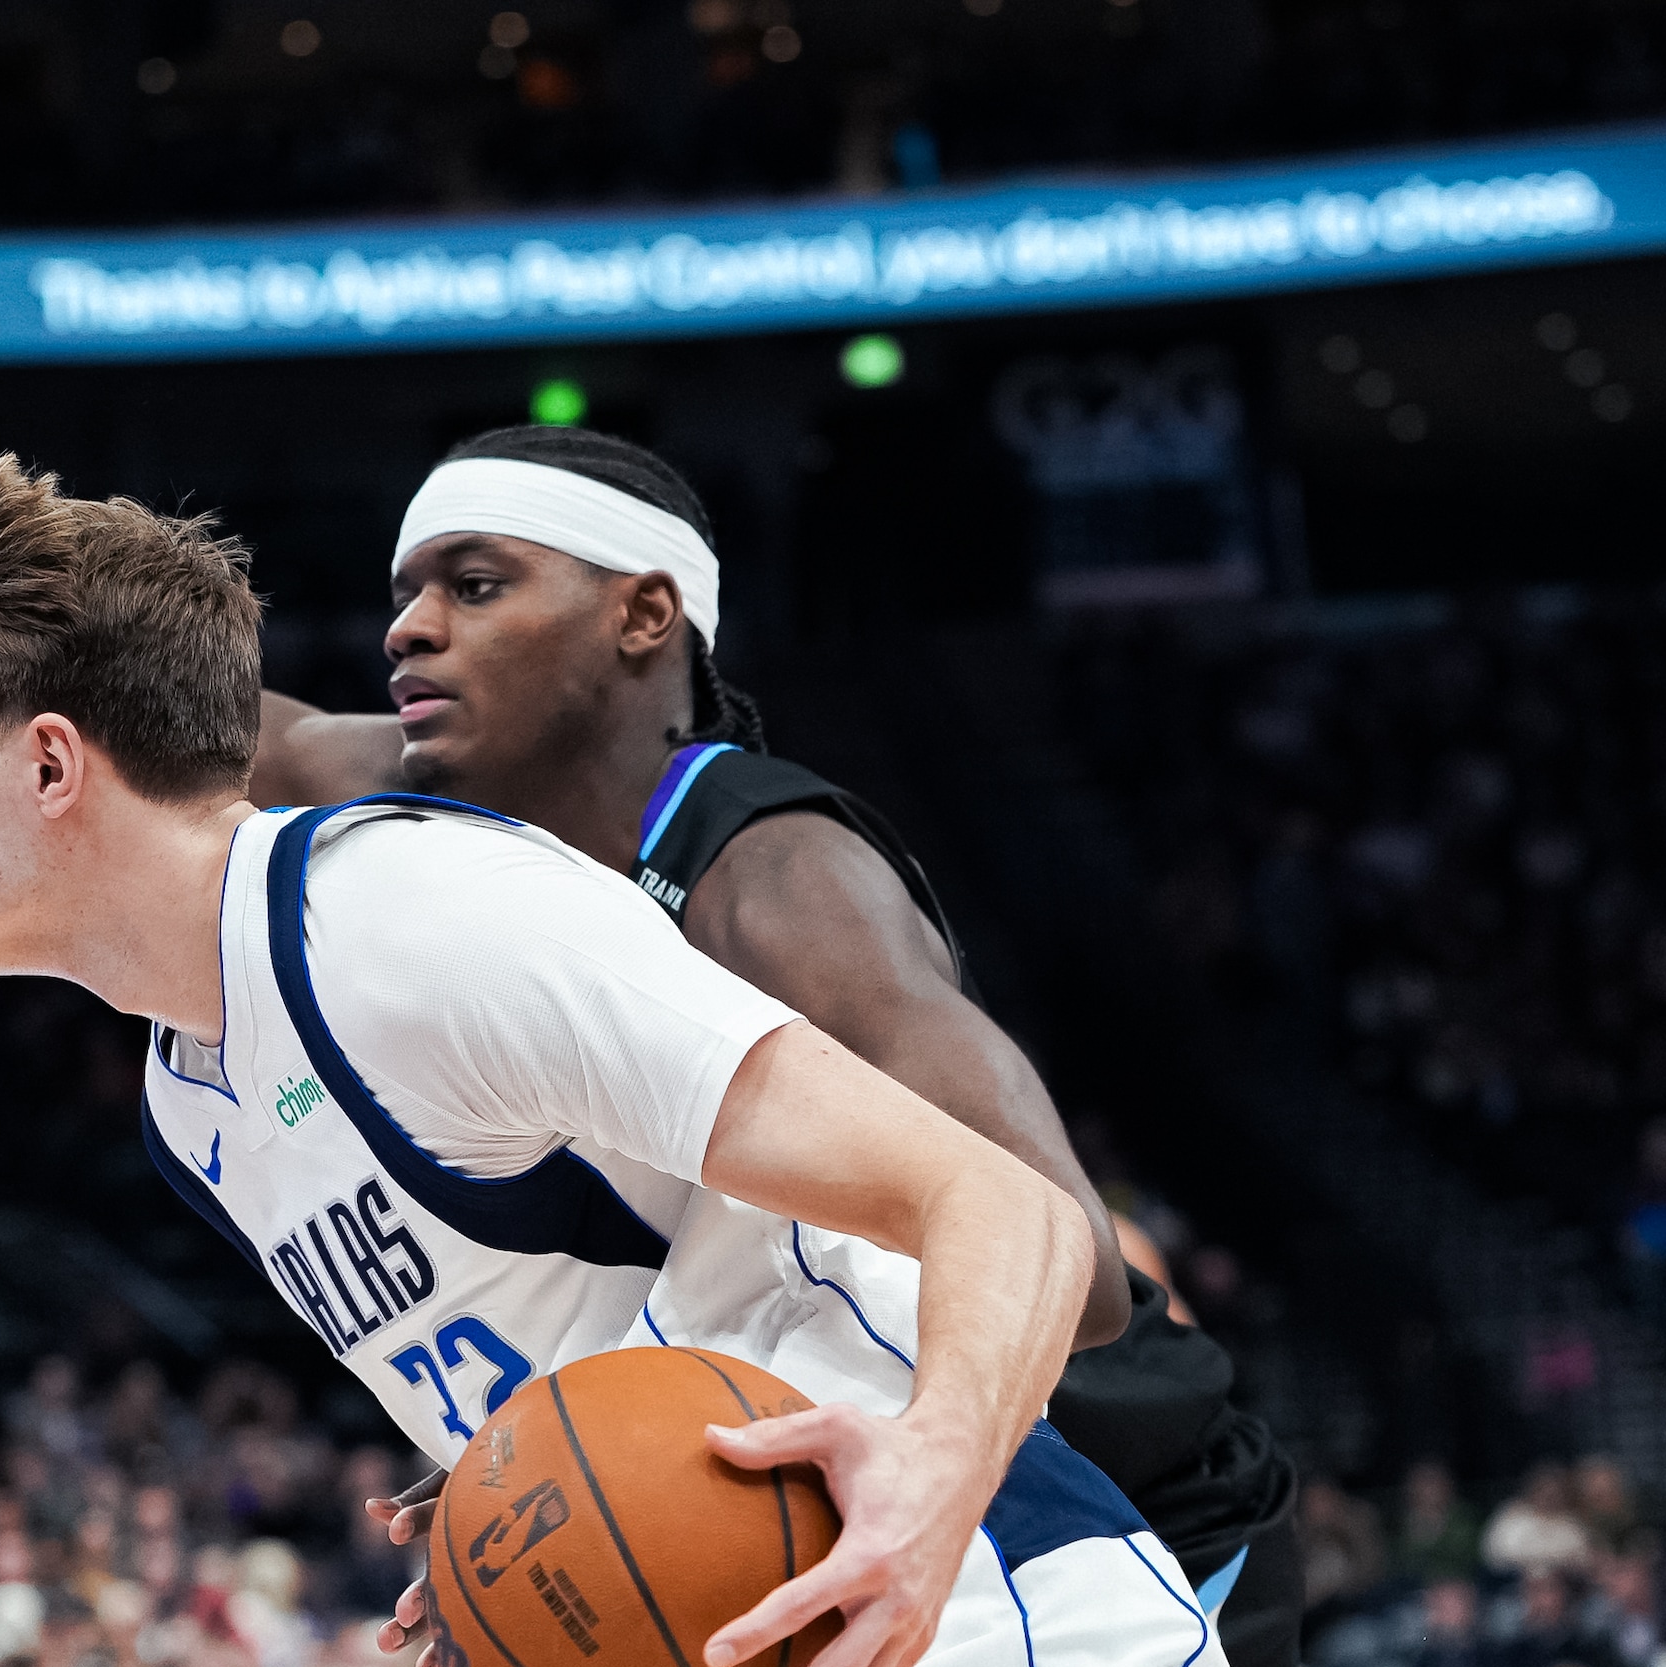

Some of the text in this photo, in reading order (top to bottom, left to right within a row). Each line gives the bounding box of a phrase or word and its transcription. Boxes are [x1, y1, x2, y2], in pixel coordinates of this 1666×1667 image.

[29, 257, 250, 335] Thanks
[251, 255, 326, 328] to
[879, 227, 995, 306] you
[1161, 200, 1298, 268] have
[1300, 188, 1374, 258] to
[267, 1173, 439, 1361] ALLAS
